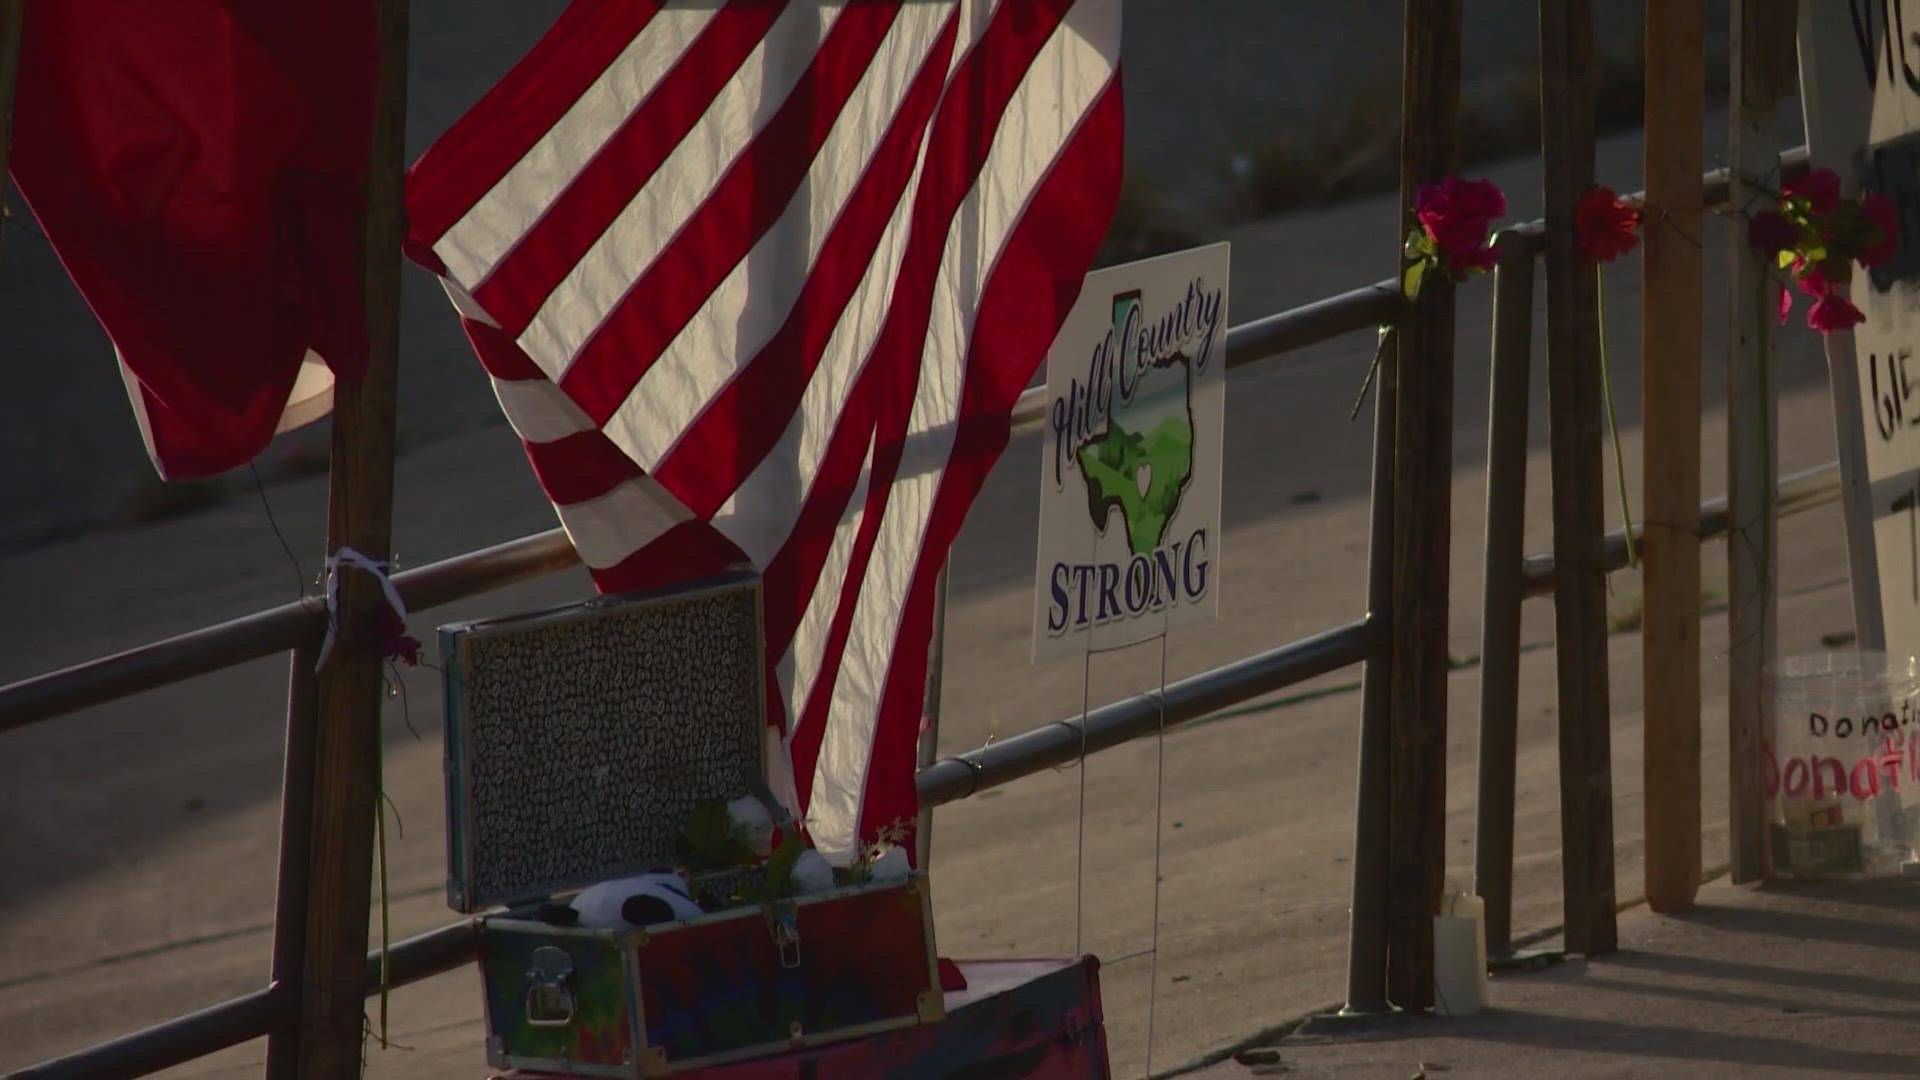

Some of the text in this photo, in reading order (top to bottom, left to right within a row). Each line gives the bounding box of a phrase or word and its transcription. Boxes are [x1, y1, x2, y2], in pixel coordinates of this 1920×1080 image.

[1052, 276, 1221, 487] Hill Country
[1047, 528, 1209, 631] STRONG
